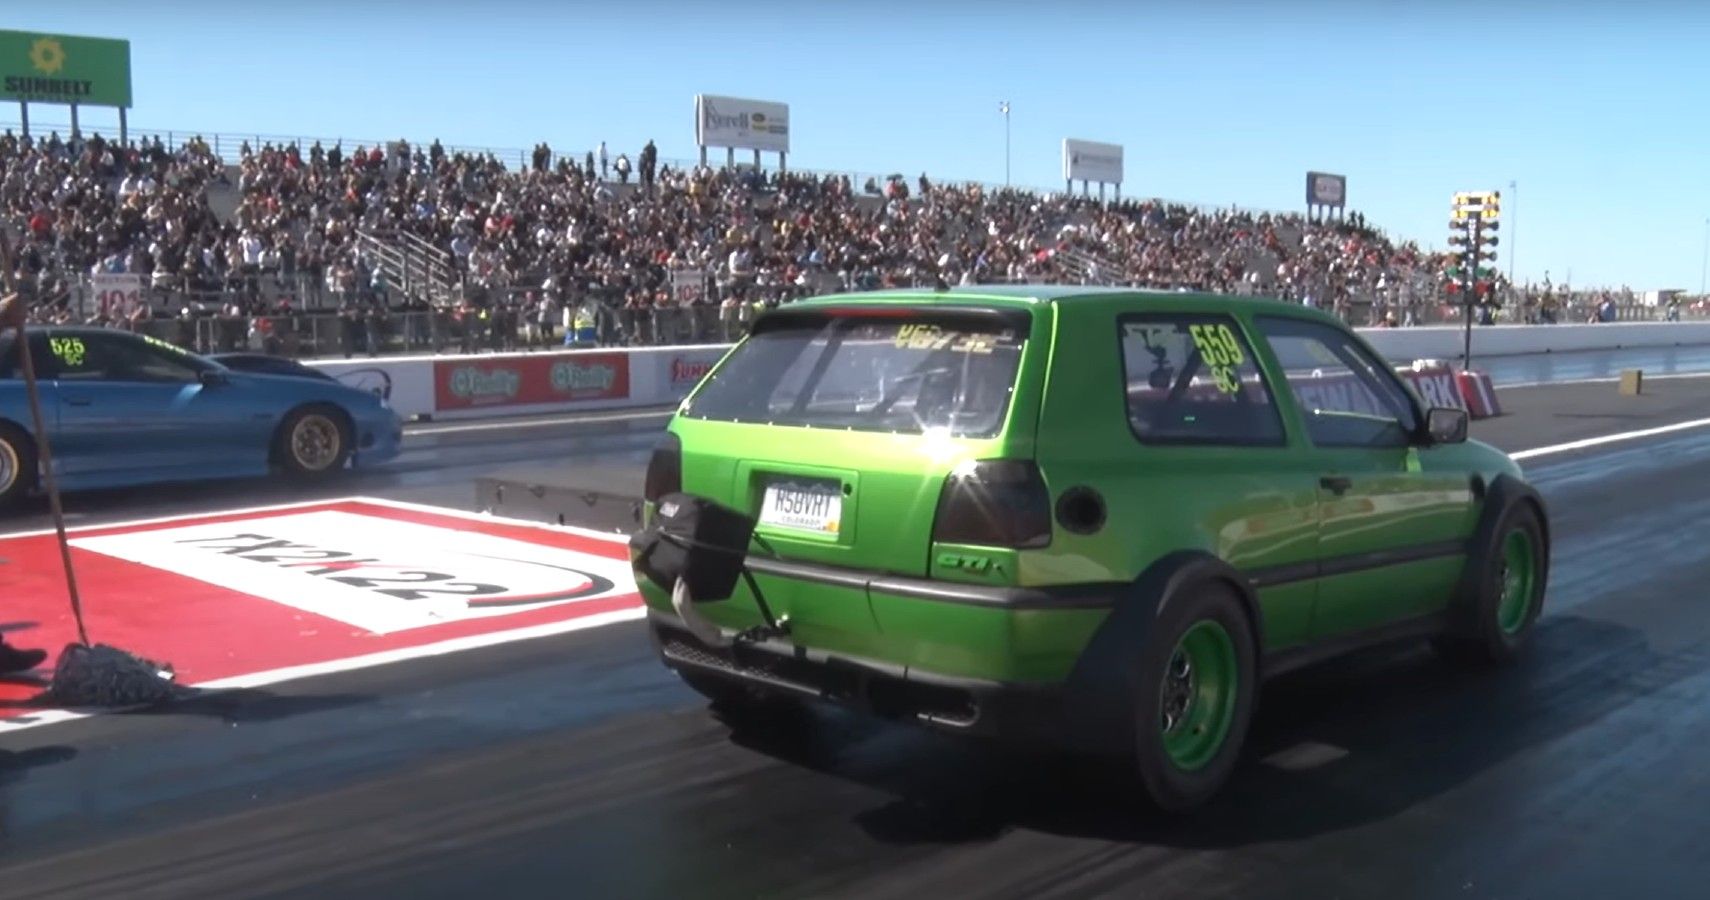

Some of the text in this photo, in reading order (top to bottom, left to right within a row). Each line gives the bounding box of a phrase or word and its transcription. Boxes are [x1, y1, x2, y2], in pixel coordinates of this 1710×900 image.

[49, 337, 86, 355] 525
[1189, 324, 1244, 366] 559
[937, 553, 990, 569] GTI
